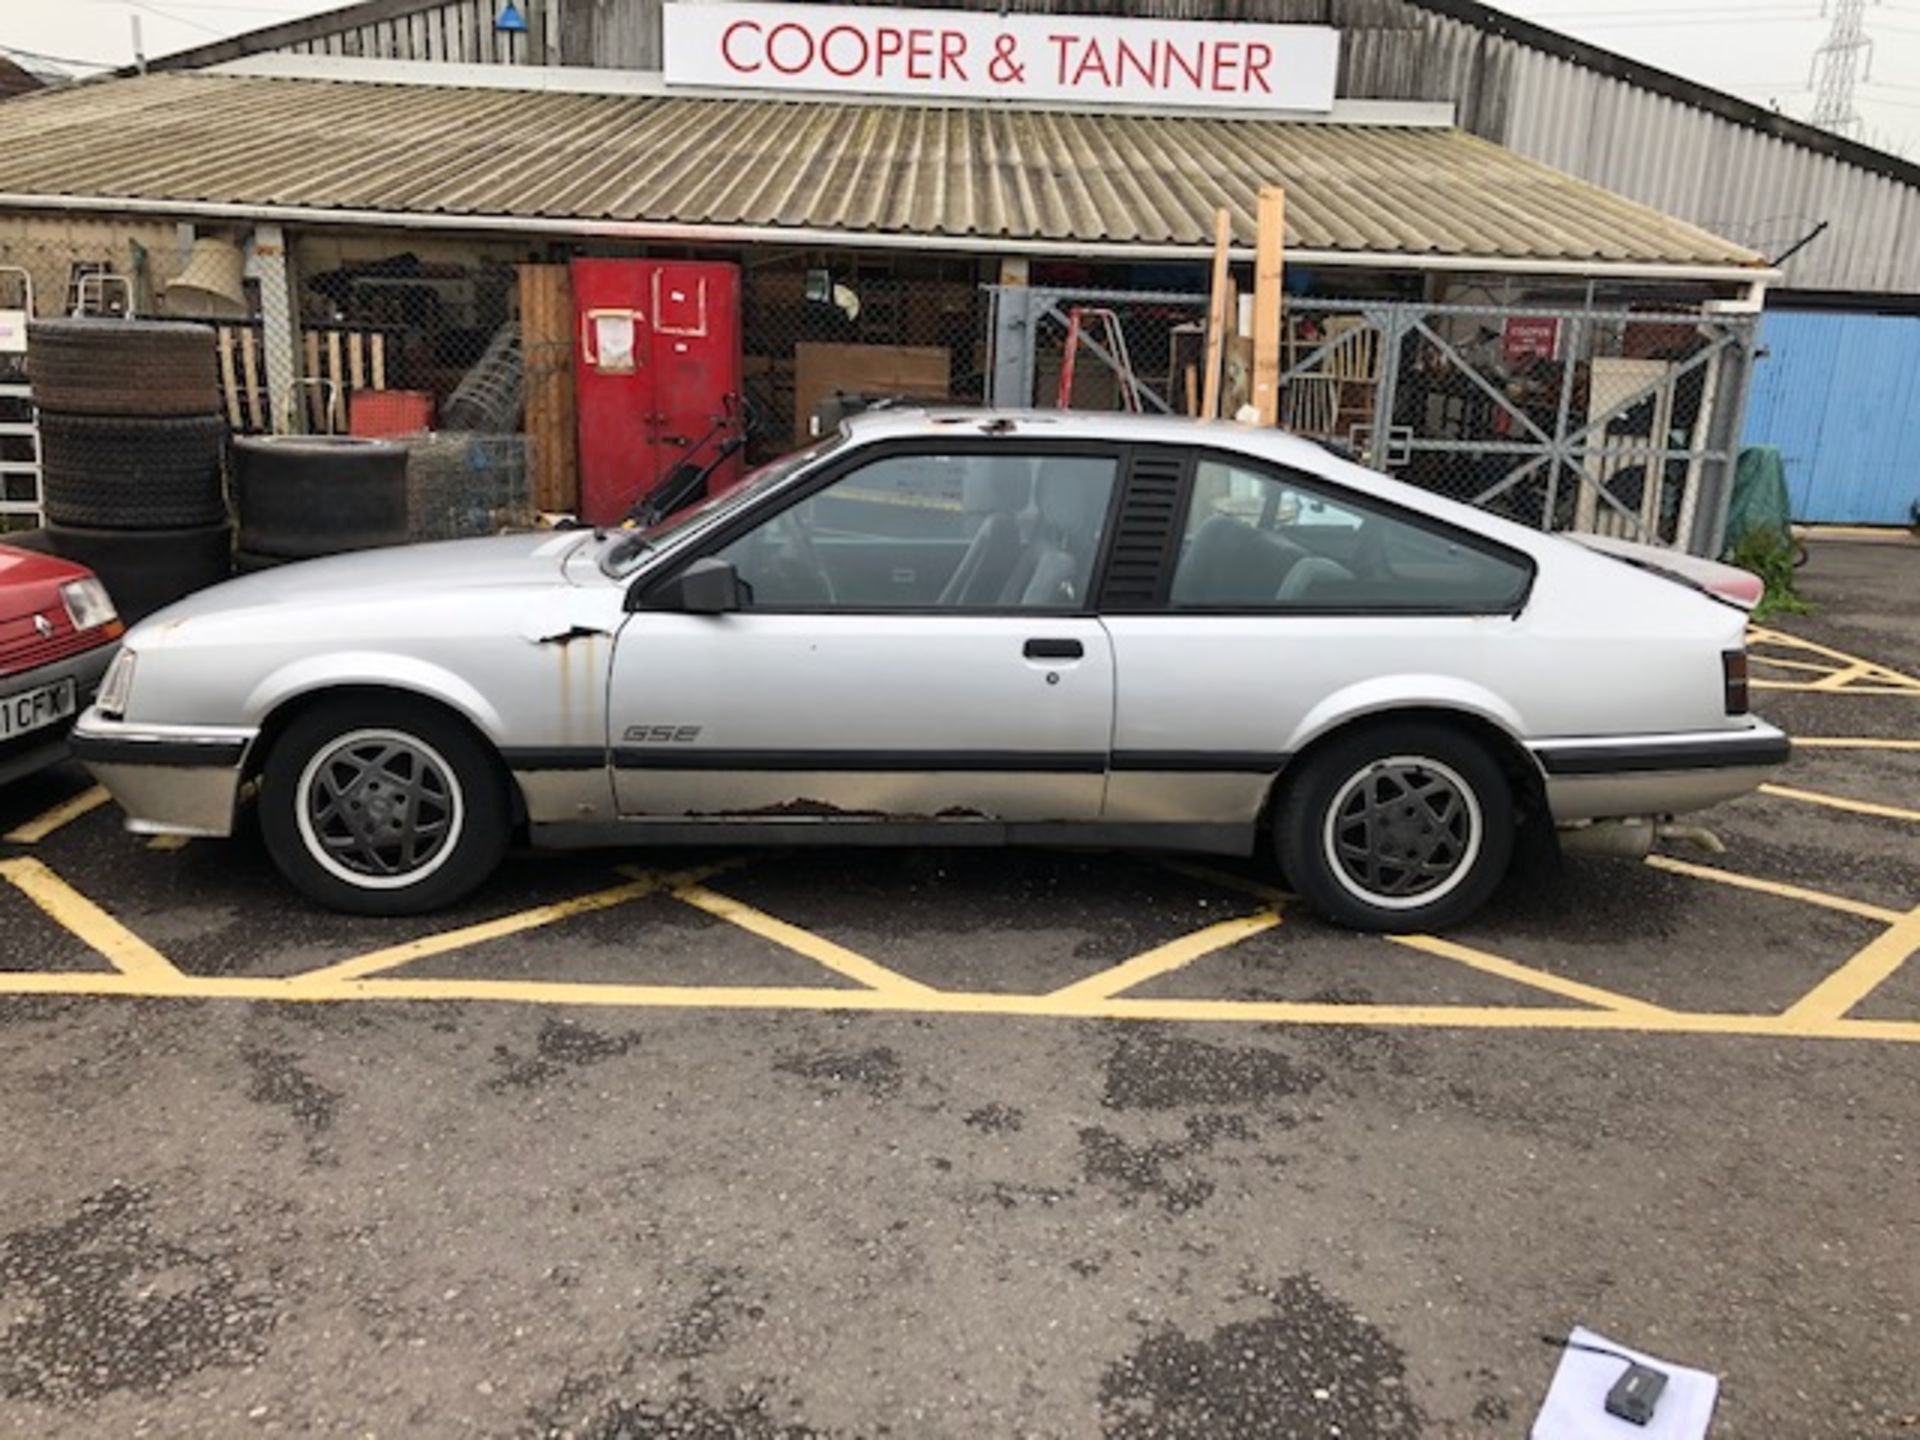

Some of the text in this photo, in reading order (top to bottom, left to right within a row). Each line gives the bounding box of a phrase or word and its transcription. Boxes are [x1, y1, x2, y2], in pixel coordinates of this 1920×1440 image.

[721, 20, 1273, 93] COOPER & TANNER
[623, 725, 703, 742] GSE
